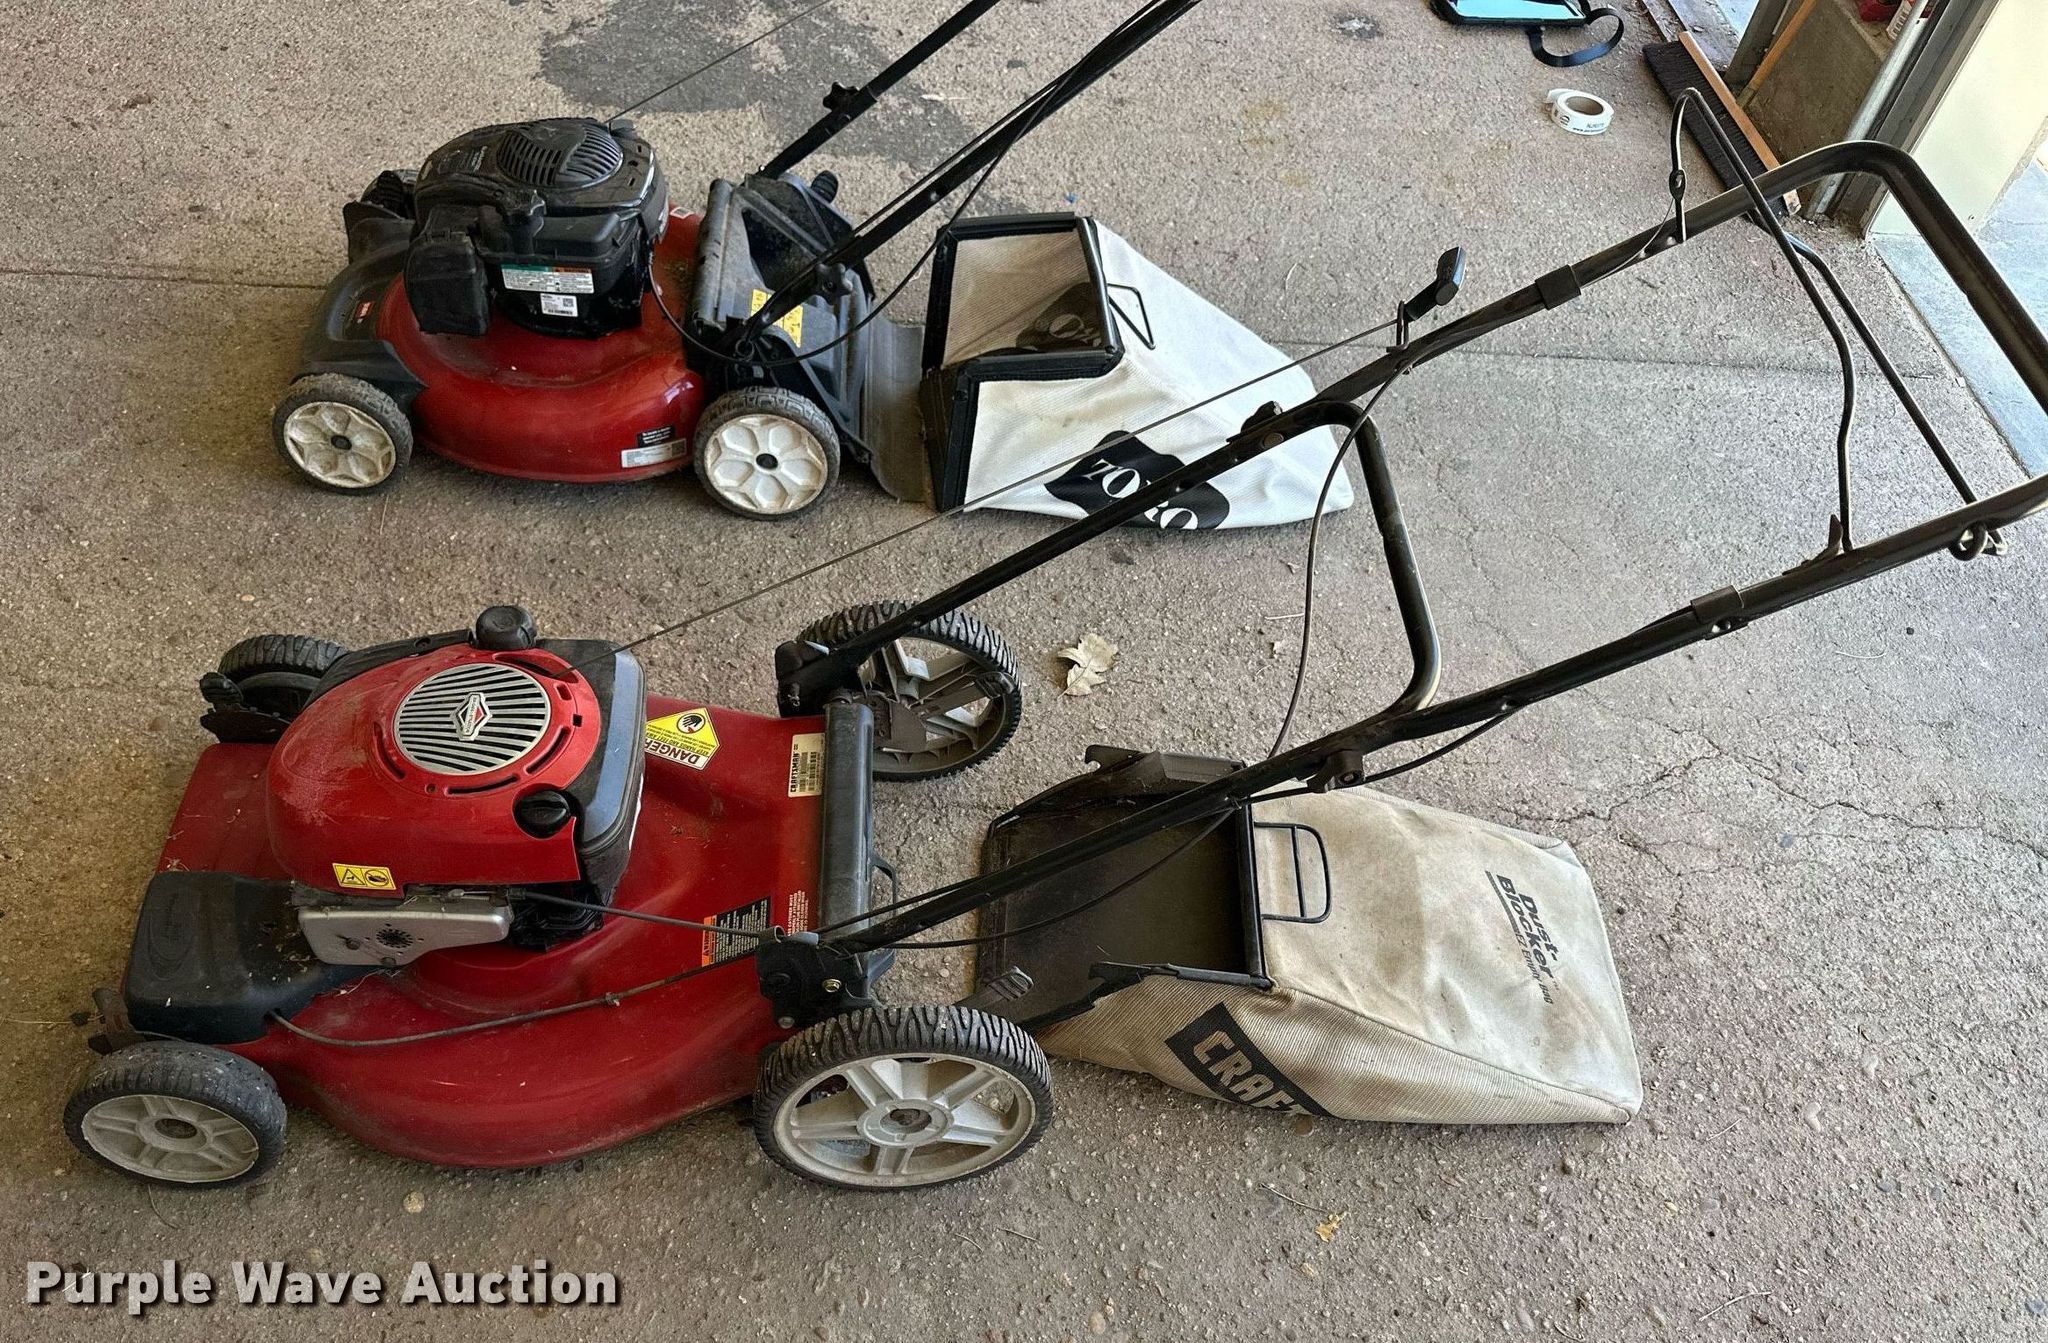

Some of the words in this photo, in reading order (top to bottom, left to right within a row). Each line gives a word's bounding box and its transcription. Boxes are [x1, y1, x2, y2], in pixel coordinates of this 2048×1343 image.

[1081, 458, 1199, 530] TOO
[790, 752, 799, 793] CRAFTSMAN
[1496, 874, 1554, 979] Blocker
[1518, 893, 1559, 961] Dust-
[1521, 948, 1542, 983] Empty
